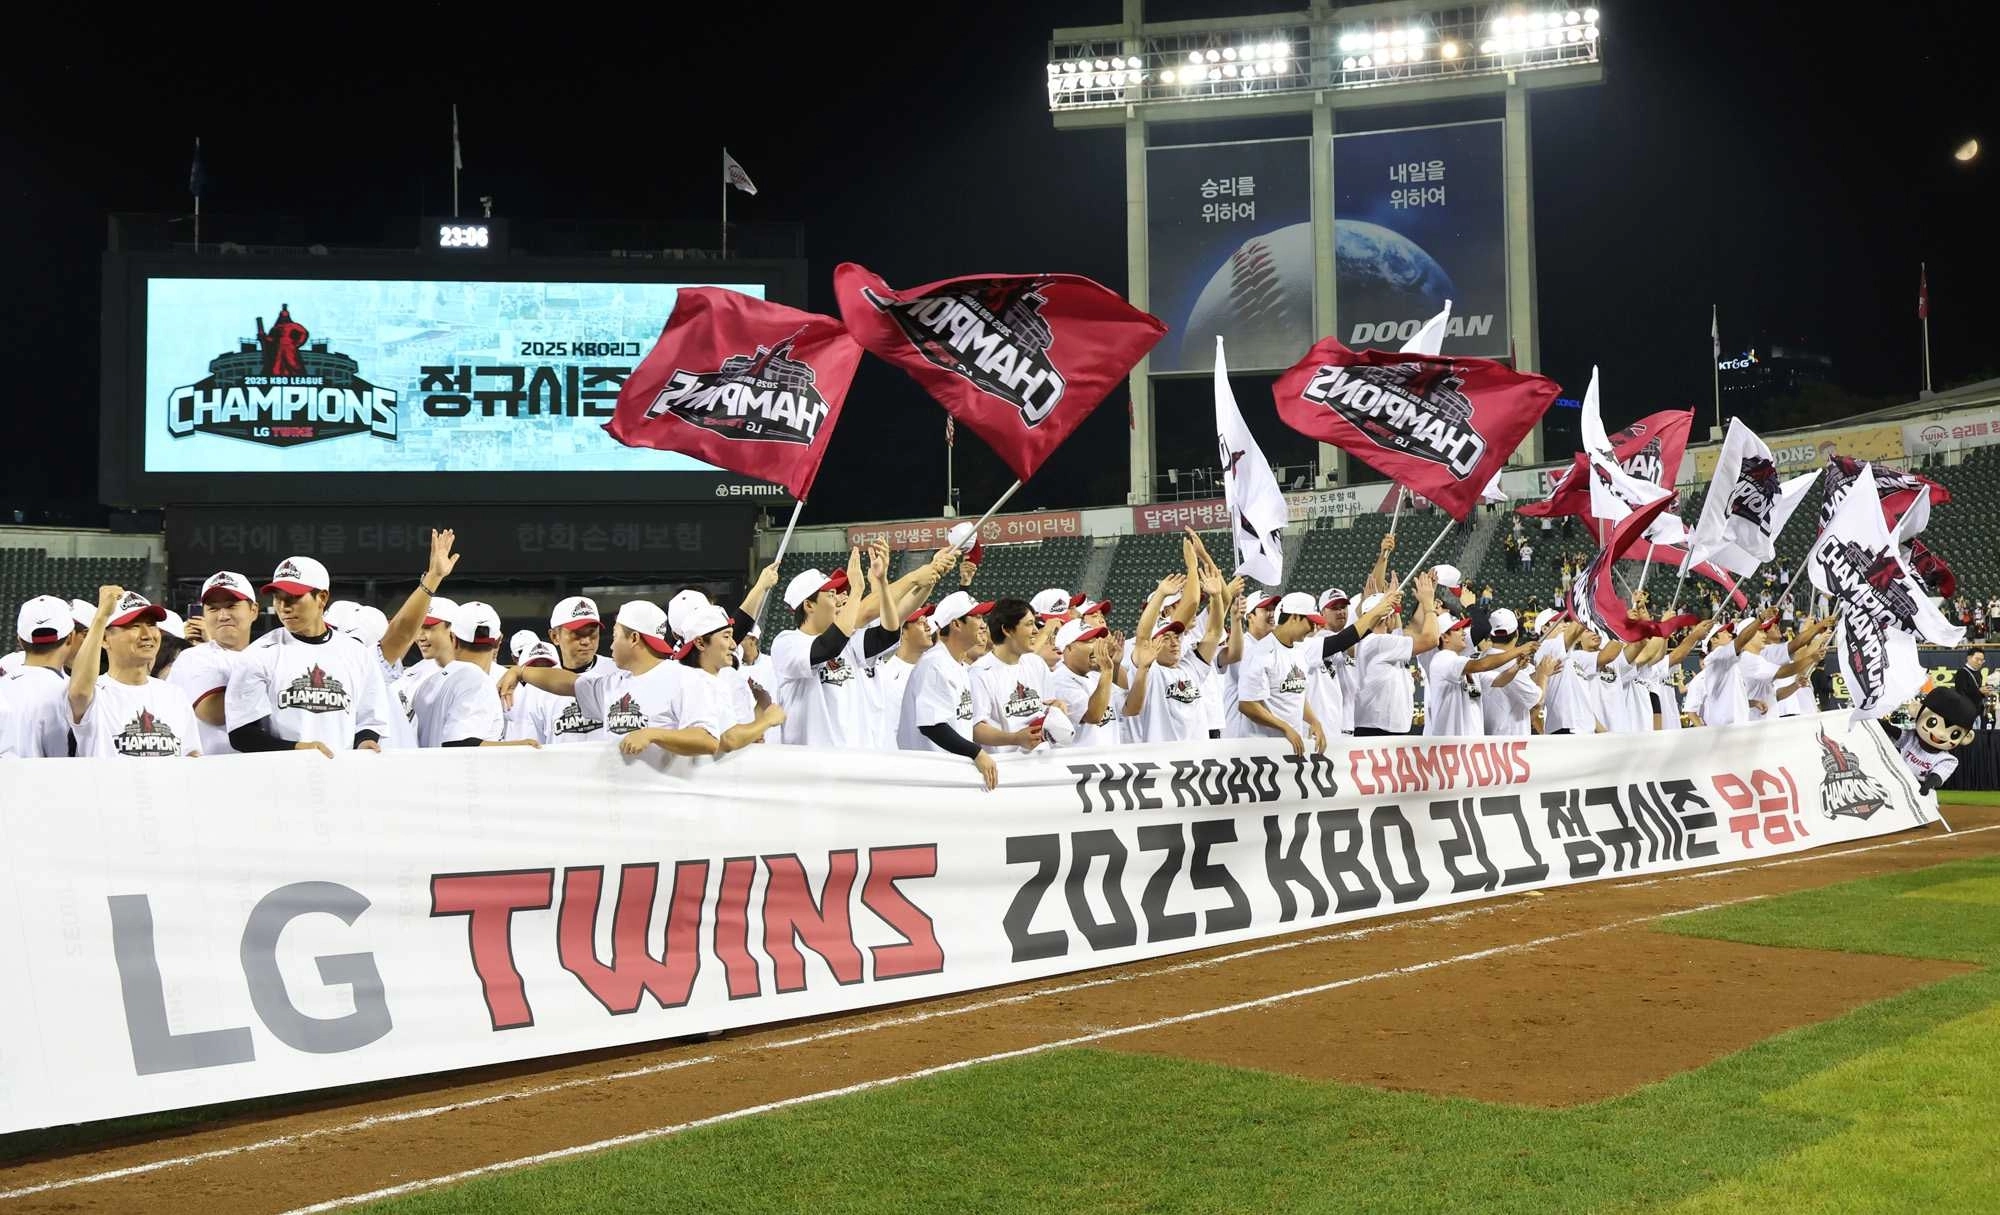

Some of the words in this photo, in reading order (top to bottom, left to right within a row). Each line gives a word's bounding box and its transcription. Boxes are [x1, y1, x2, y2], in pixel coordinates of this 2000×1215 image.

[1389, 160, 1447, 184] 내일을
[1200, 176, 1256, 199] 승리를
[1390, 186, 1446, 209] 위하여
[1201, 201, 1256, 223] 위하여
[440, 226, 489, 247] 23:06
[1350, 314, 1494, 344] DOOAN
[521, 342, 567, 356] 2025
[572, 342, 641, 357] KBO리그
[1719, 358, 1749, 370] KT&G
[244, 376, 268, 385] 2025
[270, 376, 288, 385] KBO
[290, 376, 323, 385] LEAGUE
[420, 366, 632, 417] 정규시즌
[168, 385, 398, 437] CHAMPIONS
[254, 427, 270, 437] LG
[1920, 431, 1949, 442] TWINS
[1951, 423, 1988, 439] 승리를
[729, 484, 784, 496] SAMIK
[1007, 517, 1076, 536] 하이리빙
[1144, 503, 1231, 529] 달려라병원
[188, 523, 278, 556] 시작에
[288, 523, 348, 554] 힘을
[514, 522, 703, 553] 한화손해보험
[894, 527, 933, 544] 인생은
[278, 689, 352, 714] CHAMPIONS
[1067, 762, 1163, 813] THE
[1170, 755, 1281, 808] ROAD
[1282, 753, 1338, 800] TO
[1349, 741, 1532, 795] CHAMPIONS
[1002, 818, 1252, 963] 2025
[1263, 805, 1430, 924] KBO
[1428, 794, 1550, 893] 리그
[1540, 779, 1720, 879] 정규시즌
[1711, 766, 1810, 848] 우승!
[107, 881, 393, 1076] LG
[429, 843, 945, 1032] TWINS
